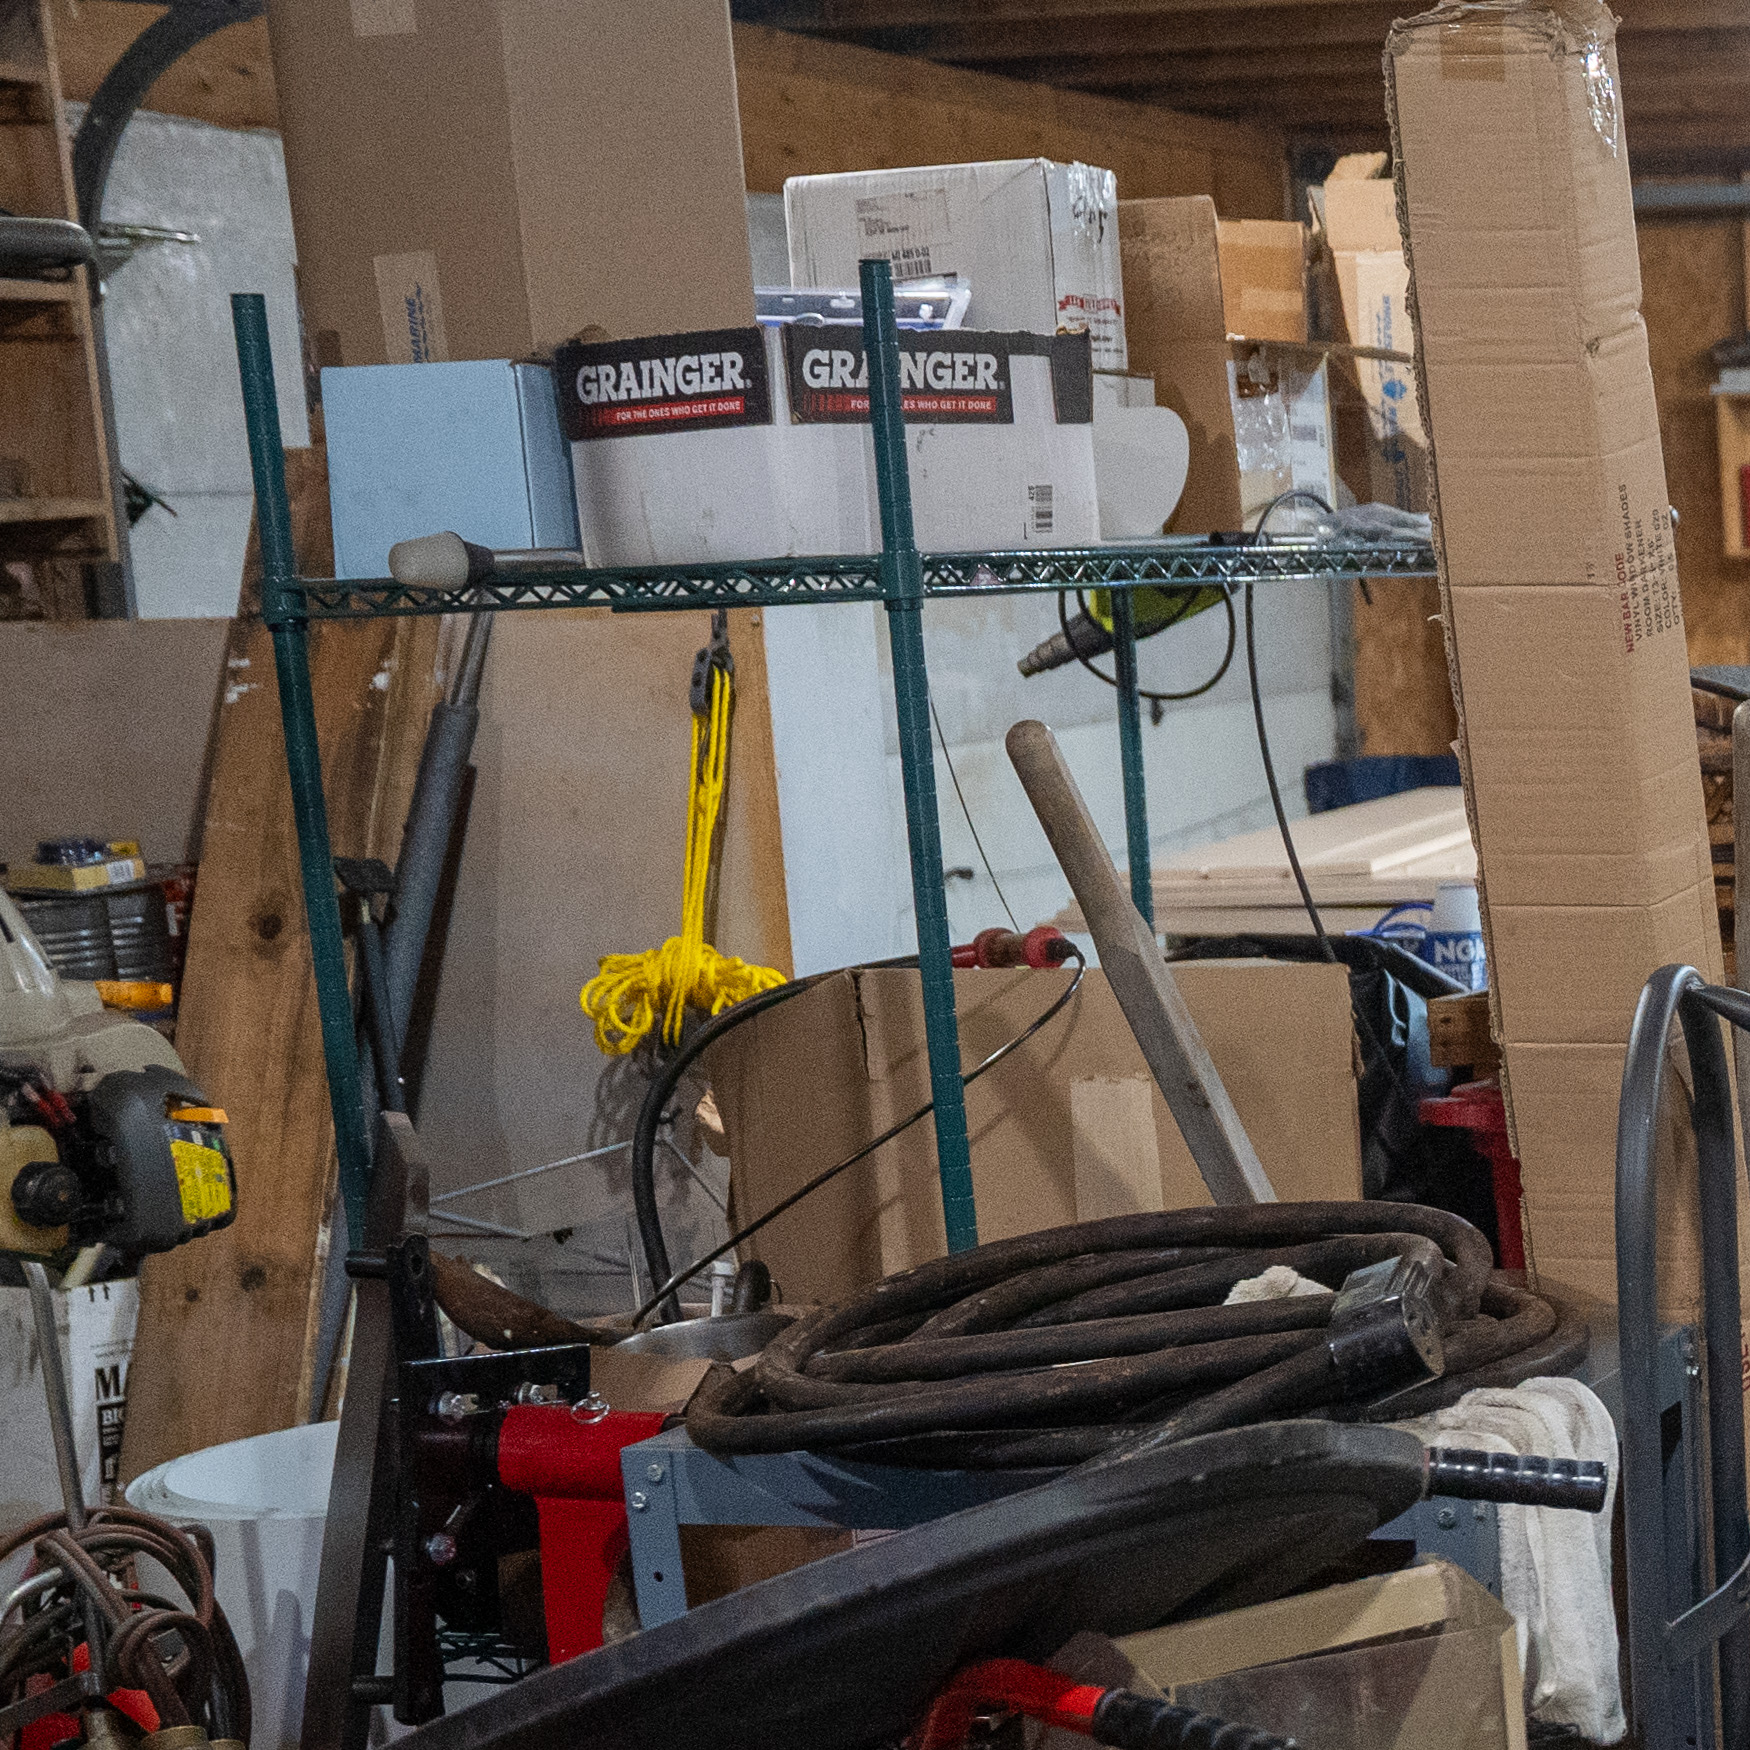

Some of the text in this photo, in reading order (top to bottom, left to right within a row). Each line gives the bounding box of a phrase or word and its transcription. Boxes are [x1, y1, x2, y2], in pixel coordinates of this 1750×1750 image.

[576, 351, 744, 405] GRAINGER
[616, 399, 741, 421] FOR THE ONES WHO GET IT DONE
[850, 399, 869, 410] FOR
[916, 399, 938, 410] WHO
[939, 399, 957, 410] GET
[957, 399, 966, 410] IT
[967, 399, 992, 411] DONE
[1618, 483, 1634, 540] SHADES
[1619, 591, 1631, 620] BAR
[1631, 601, 1643, 642] VINYL
[1643, 595, 1654, 637] ROOM
[1624, 624, 1635, 654] NEW
